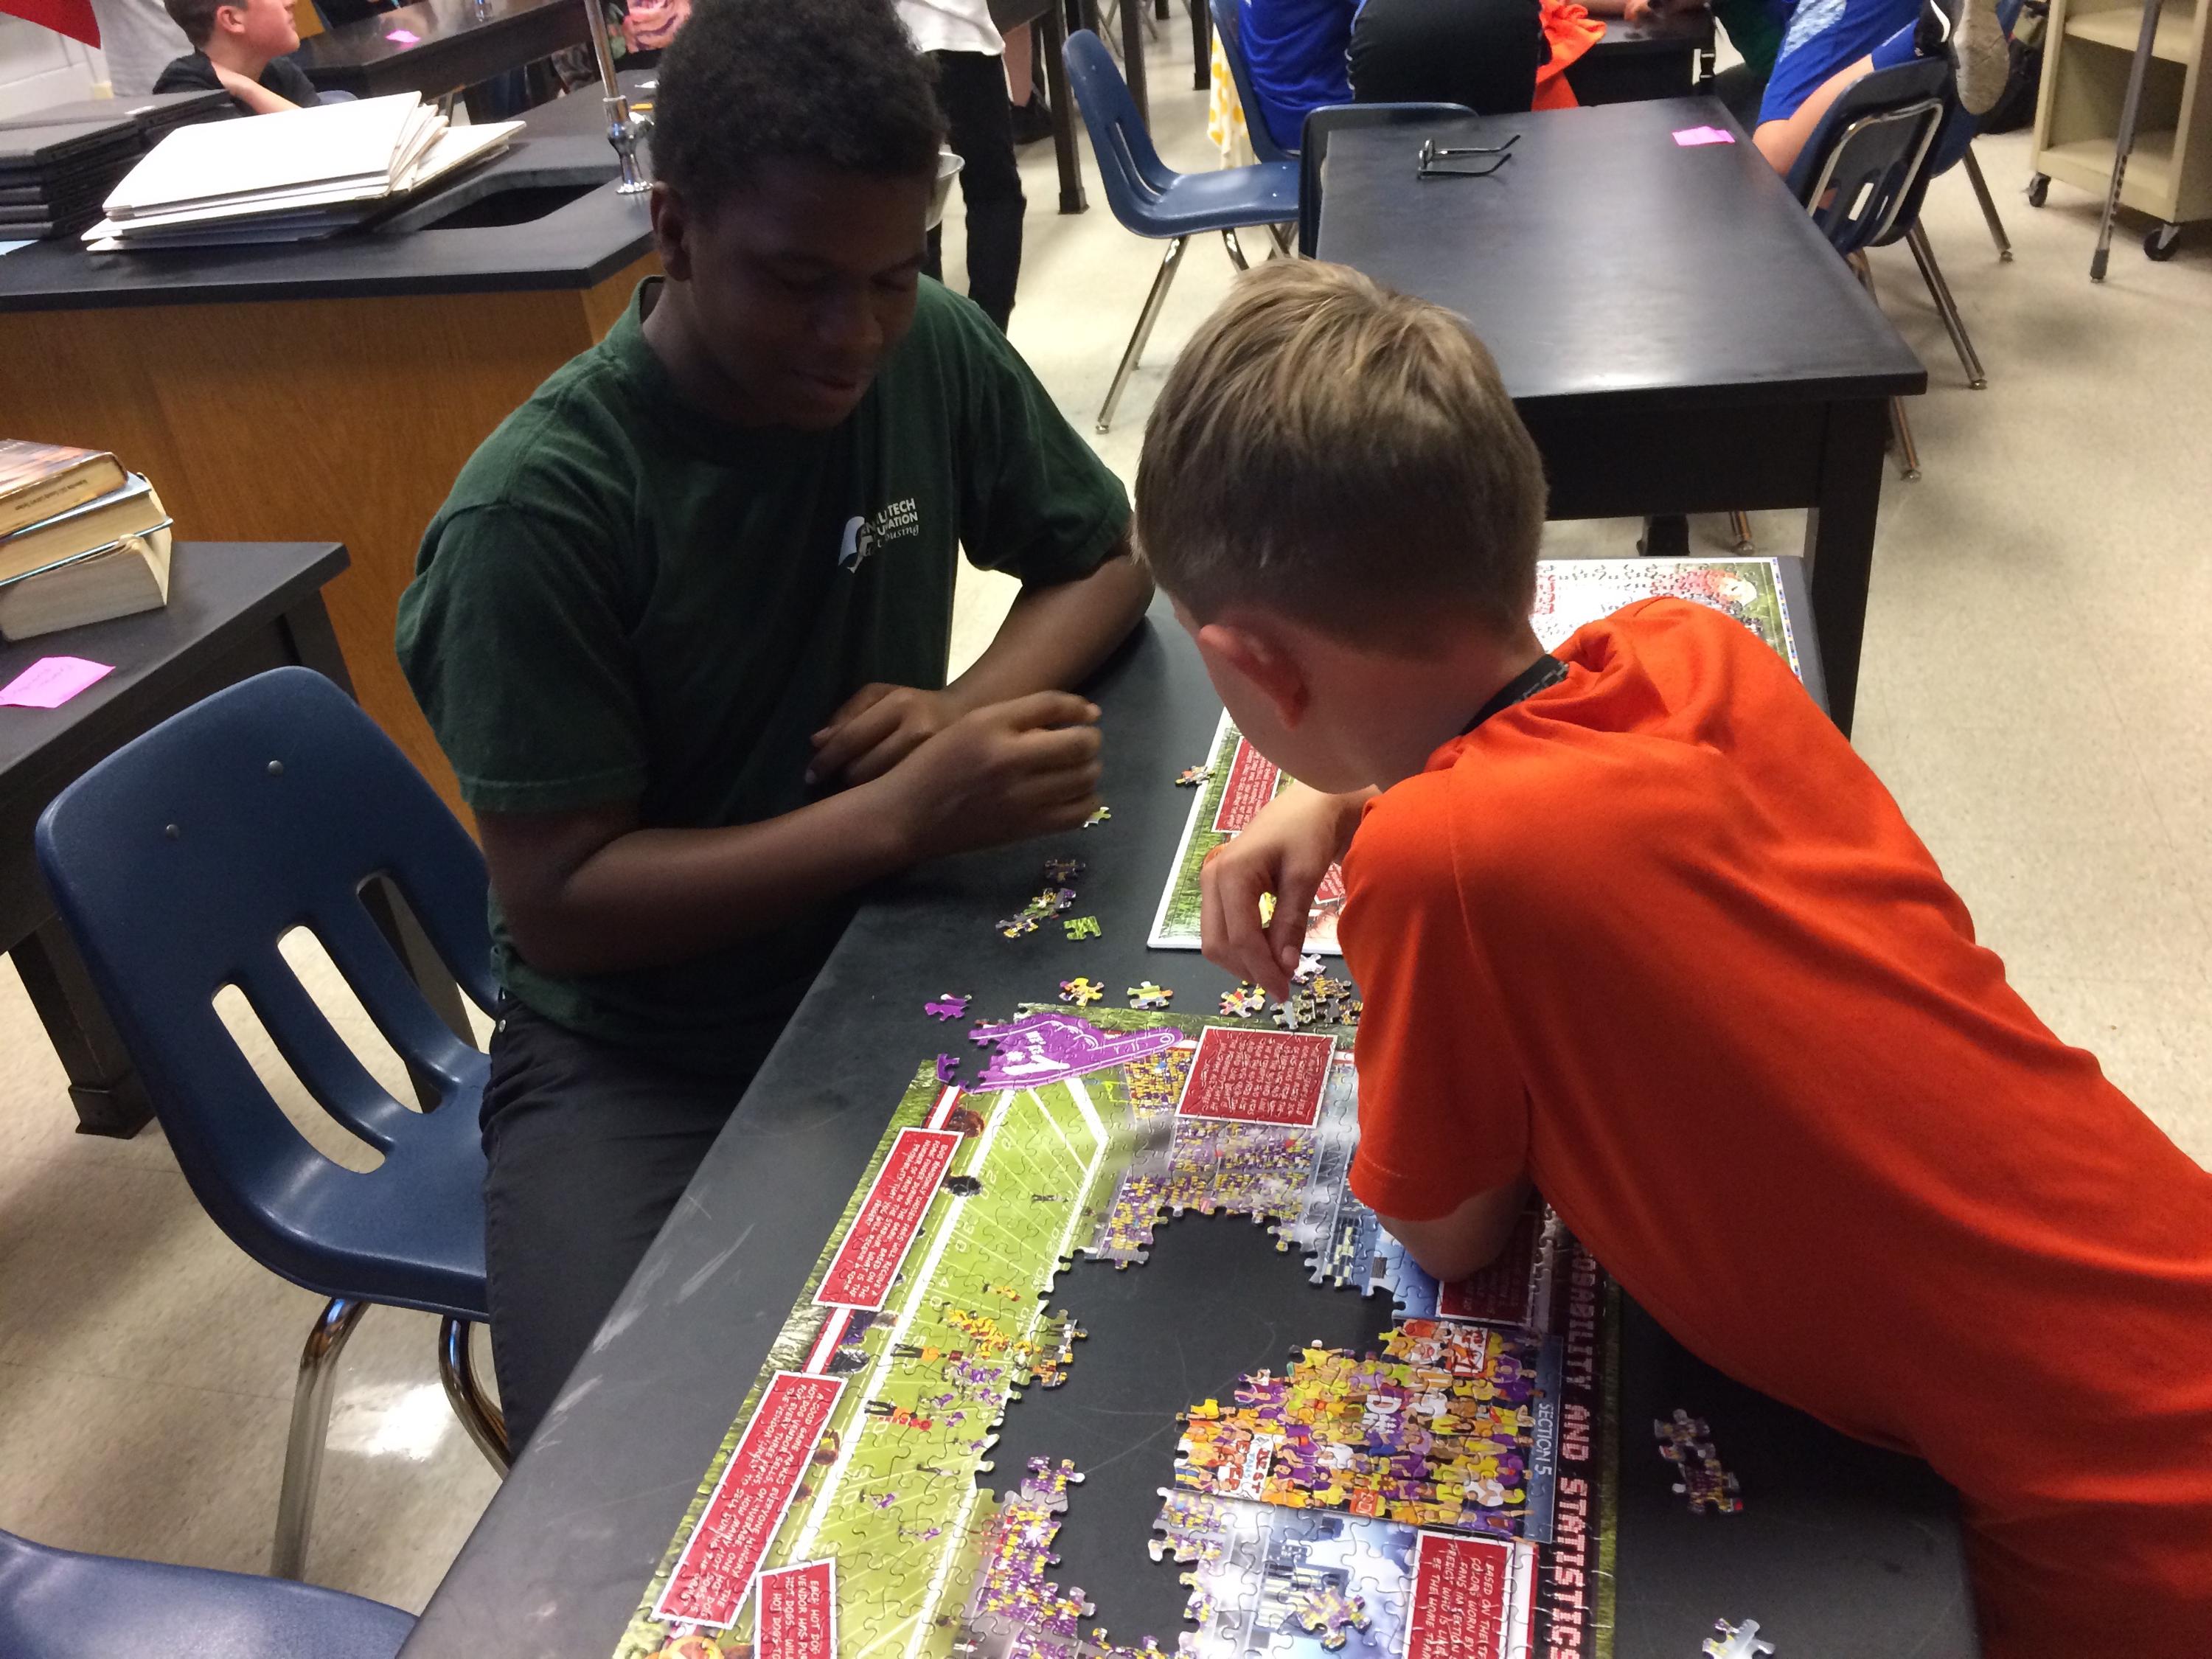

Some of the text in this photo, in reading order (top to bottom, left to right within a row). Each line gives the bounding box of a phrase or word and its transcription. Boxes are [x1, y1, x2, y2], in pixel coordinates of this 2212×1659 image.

[908, 1166, 918, 1175] OF
[887, 1183, 900, 1199] THAT
[900, 1175, 914, 1192] FANS
[879, 1200, 891, 1214] YOU
[896, 1194, 904, 1202] IN
[888, 1203, 900, 1216] THE
[897, 1207, 908, 1220] THE
[905, 1196, 923, 1221] CHOSEN
[870, 1215, 883, 1231] WILL
[897, 1222, 910, 1240] FANS
[872, 1247, 888, 1270] BASED
[887, 1242, 900, 1259] WILL
[860, 1251, 876, 1272] WHAT
[856, 1273, 866, 1281] IS
[866, 1271, 876, 1282] ON
[873, 1261, 892, 1288] RECEIVE
[848, 1283, 860, 1297] THE
[858, 1284, 870, 1299] THE
[793, 1384, 807, 1399] FOR
[805, 1382, 818, 1399] HOT
[779, 1402, 798, 1429] EVERY
[796, 1399, 810, 1417] DOG
[803, 1402, 820, 1425] GOOD
[778, 1419, 800, 1453] VENDOR
[790, 1427, 807, 1451] GAME
[1533, 1403, 1555, 1475] SECTION 5
[1562, 1404, 1590, 1462] AND
[765, 1432, 783, 1458] THREE
[740, 1473, 751, 1486] TO
[728, 1488, 744, 1509] SELL
[736, 1494, 752, 1516] HOW
[720, 1517, 741, 1548] MANY
[720, 1552, 736, 1572] ONE
[1431, 1557, 1441, 1570] BE
[1550, 1478, 1588, 1659] STATISTICS
[785, 1576, 794, 1596] HOT
[1428, 1573, 1440, 1594] THE
[1482, 1563, 1495, 1595] BASED
[716, 1587, 731, 1607] THE
[772, 1593, 782, 1610] HOT
[798, 1575, 807, 1613] VENDOR
[1440, 1587, 1452, 1611] WHO
[699, 1596, 714, 1617] DOG
[1425, 1597, 1438, 1628] HOME
[1448, 1561, 1468, 1652] FANS IN SECTION
[1464, 1600, 1478, 1632] WORN
[1481, 1599, 1492, 1615] ON
[798, 1618, 806, 1639] HAS
[810, 1609, 820, 1630] HOT
[1439, 1615, 1450, 1624] IS
[1478, 1620, 1489, 1640] THE
[810, 1633, 820, 1654] DOG
[1463, 1635, 1474, 1652] BY
